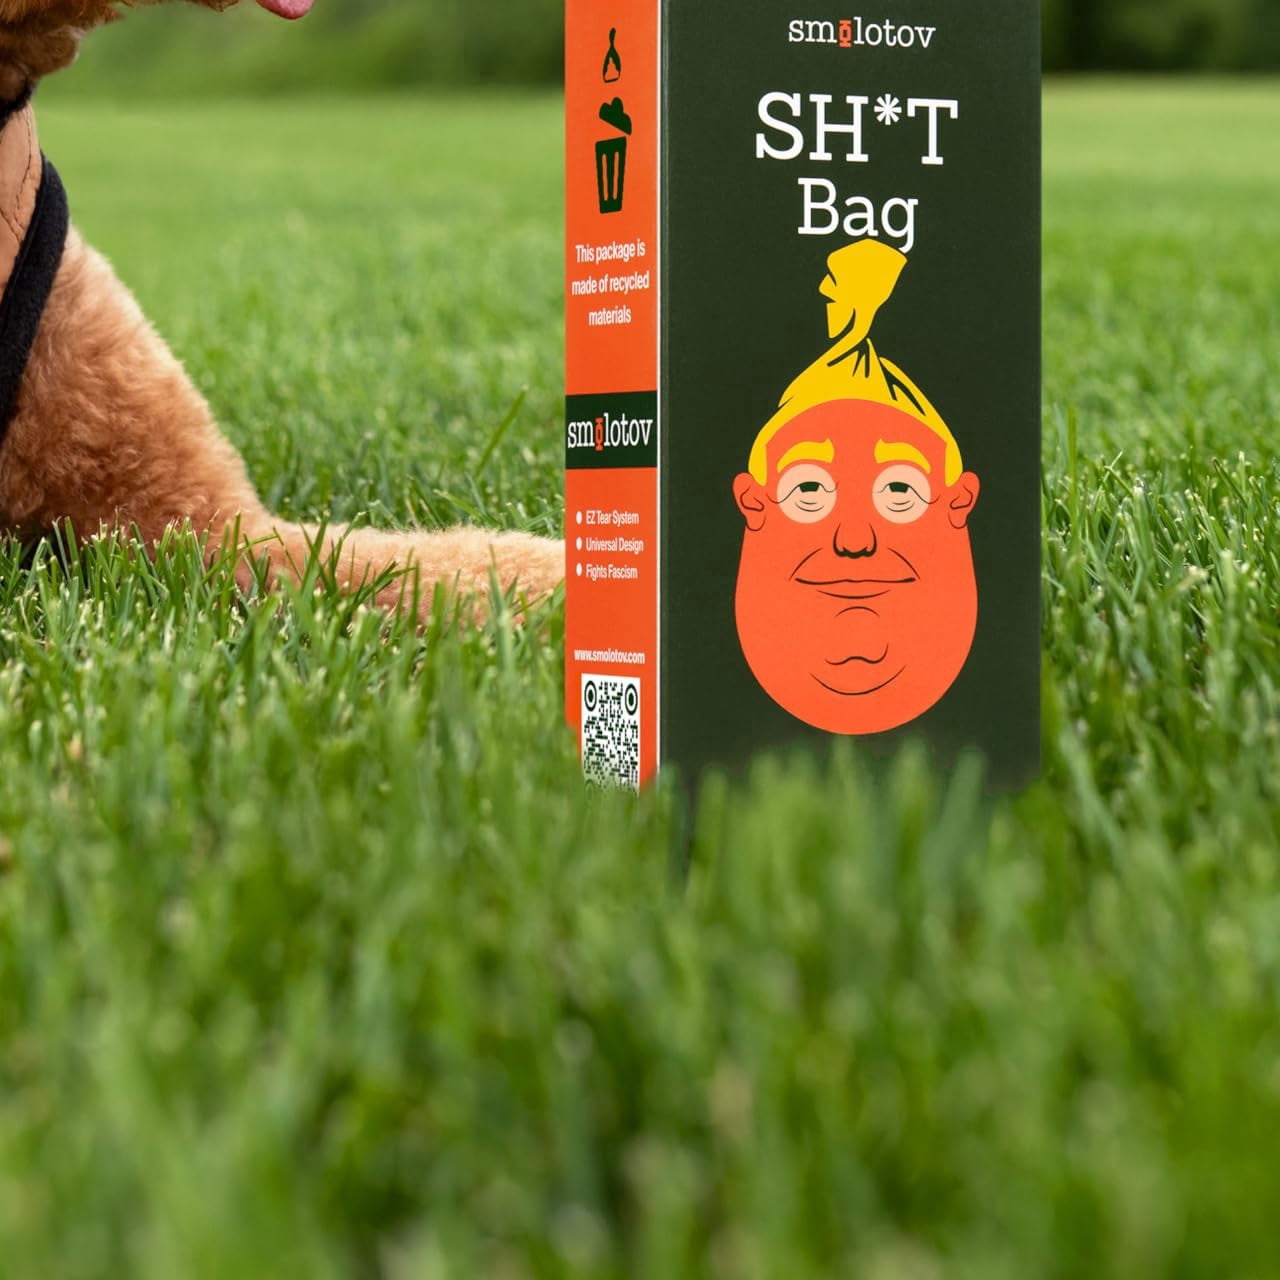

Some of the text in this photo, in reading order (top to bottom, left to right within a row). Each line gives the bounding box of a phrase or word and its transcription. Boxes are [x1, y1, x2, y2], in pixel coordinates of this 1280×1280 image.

[797, 177, 919, 254] Bag
[575, 238, 646, 265] This package is
[571, 270, 650, 296] made of recycled
[588, 305, 632, 326] materials
[585, 509, 640, 527] EZ Tear System
[585, 537, 644, 555] Universal Design
[585, 564, 638, 581] Fights Fascism
[574, 648, 646, 664] www.smolotov.com
